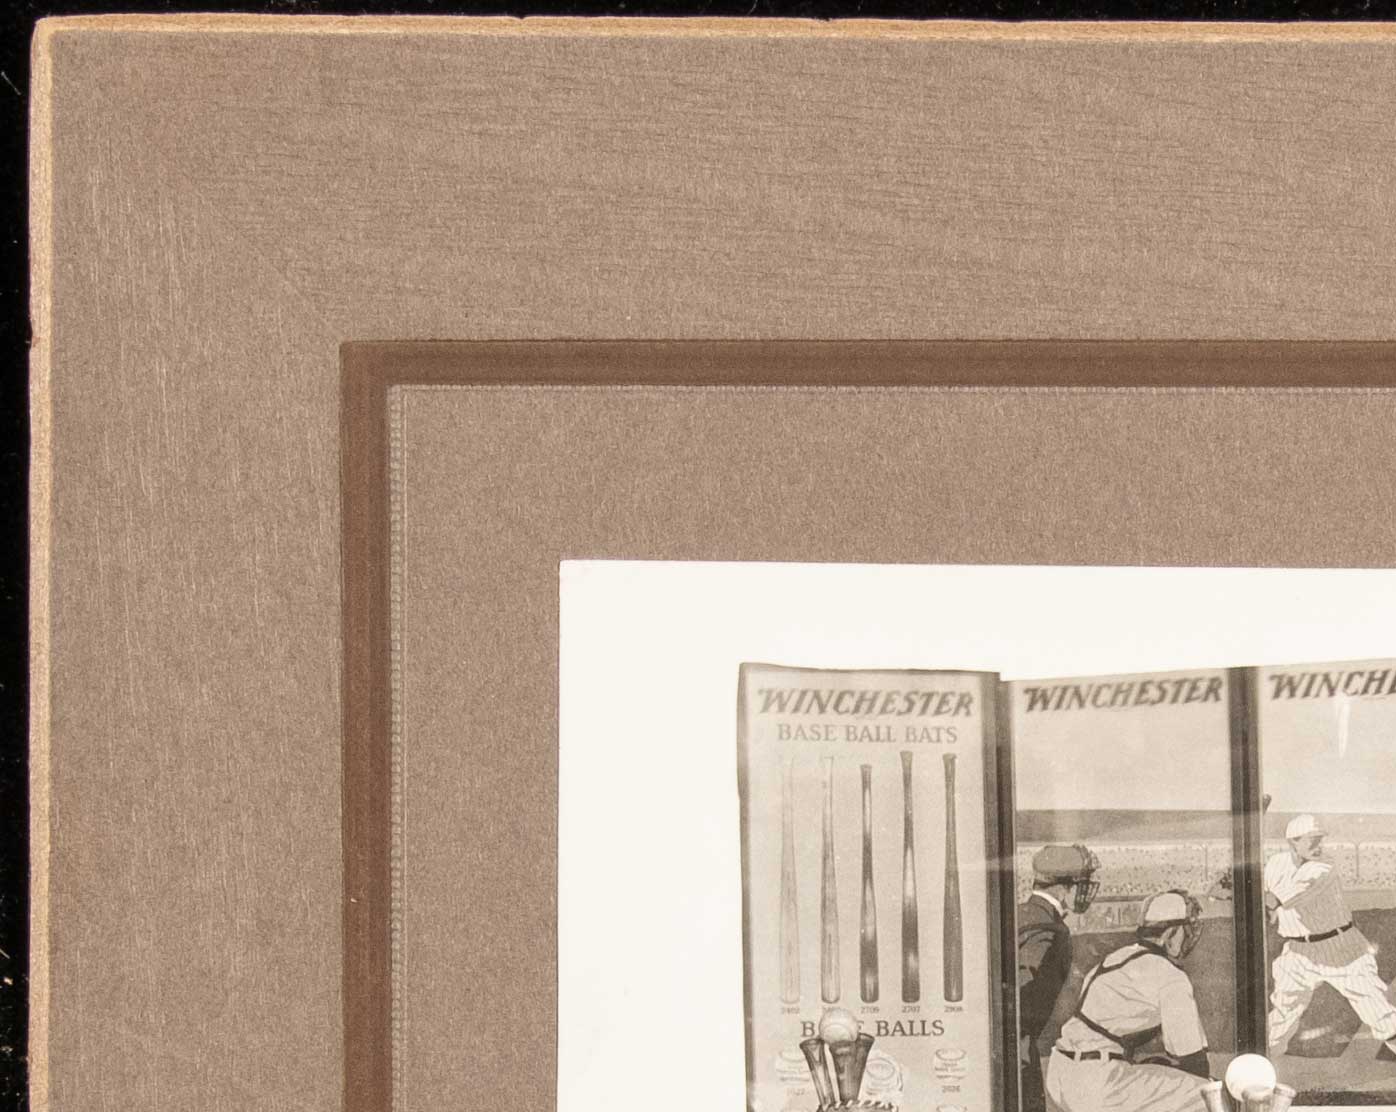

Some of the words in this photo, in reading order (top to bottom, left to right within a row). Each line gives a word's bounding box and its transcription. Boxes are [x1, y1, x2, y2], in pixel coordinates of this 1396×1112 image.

[758, 688, 974, 717] WINCHESTER
[1022, 677, 1223, 712] WINCHESTER
[777, 723, 837, 742] BASE
[845, 724, 896, 743] BALL
[905, 726, 958, 743] BATS
[875, 1020, 945, 1037] BALLS
